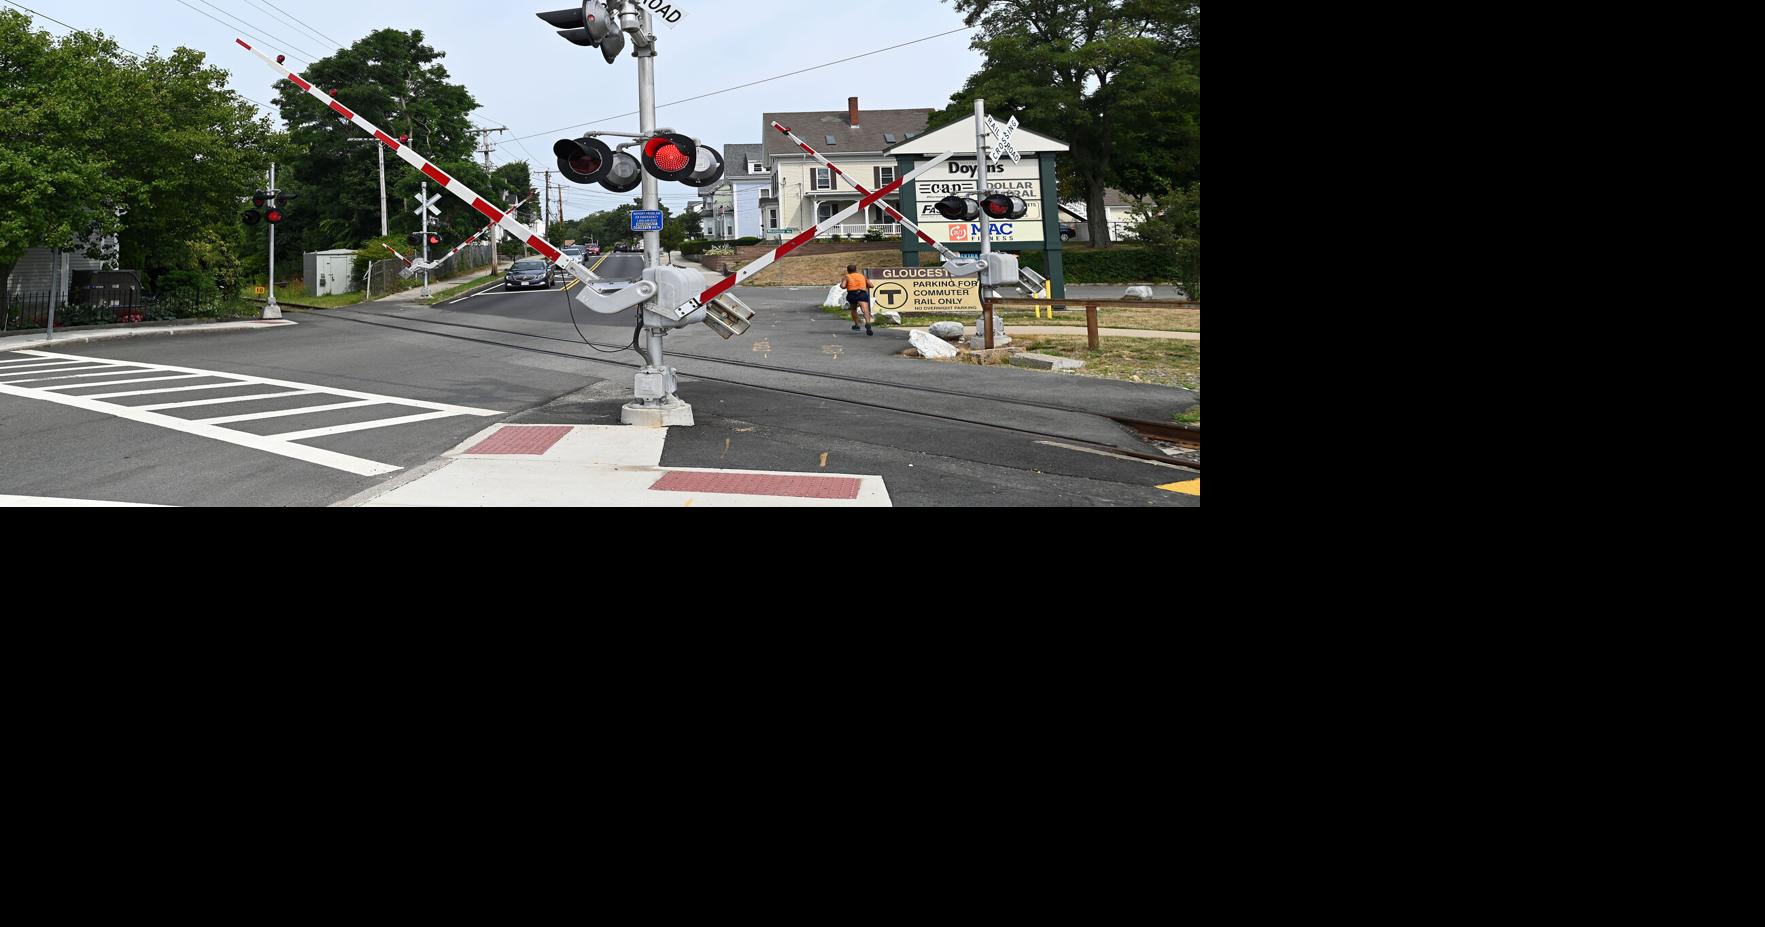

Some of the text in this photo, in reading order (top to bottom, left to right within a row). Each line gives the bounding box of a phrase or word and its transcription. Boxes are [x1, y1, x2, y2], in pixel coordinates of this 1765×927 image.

[643, 0, 682, 23] OAD
[987, 117, 1020, 162] RAIL ROAD
[992, 120, 1017, 160] CROSSING
[948, 162, 1005, 178] Doyn's
[986, 181, 1033, 190] DOLLAR
[882, 268, 956, 278] GLOUCEST
[879, 289, 901, 305] T
